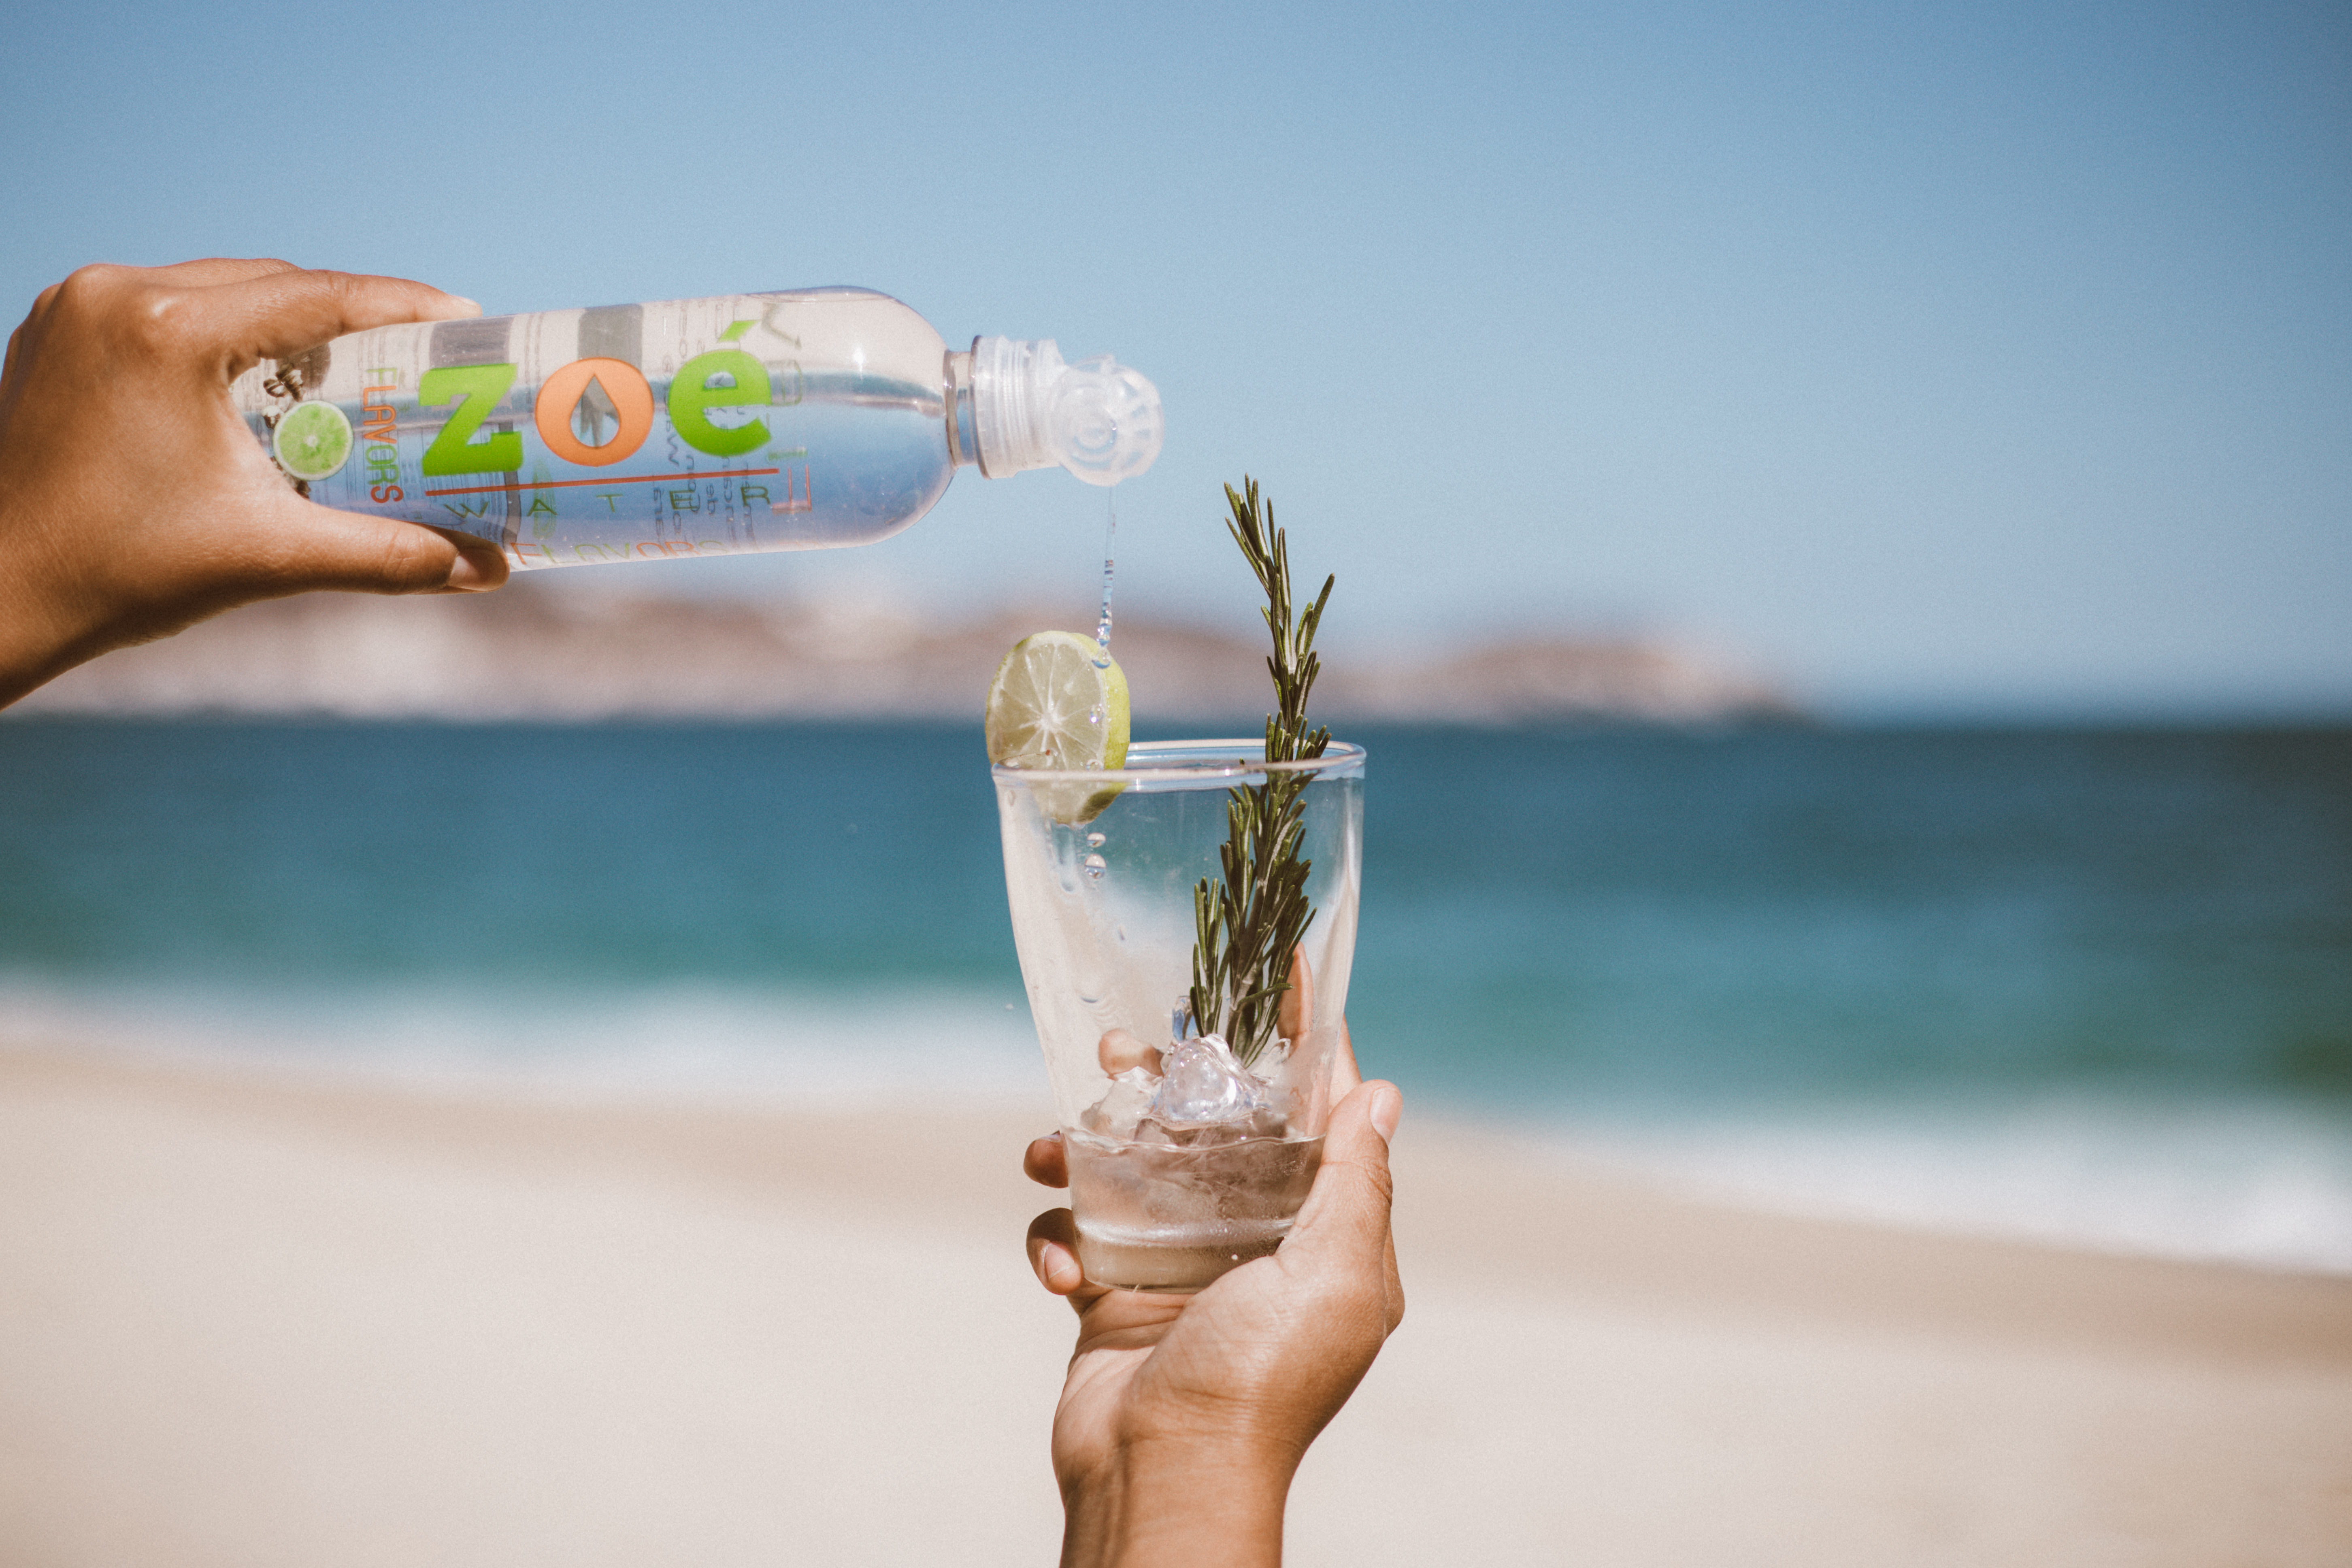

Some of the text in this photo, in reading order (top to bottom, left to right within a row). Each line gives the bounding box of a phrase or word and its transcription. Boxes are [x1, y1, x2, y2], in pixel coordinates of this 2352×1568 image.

[363, 367, 404, 504] FLAVORS
[443, 486, 771, 519] WATER
[510, 540, 729, 565] FLAVORS
